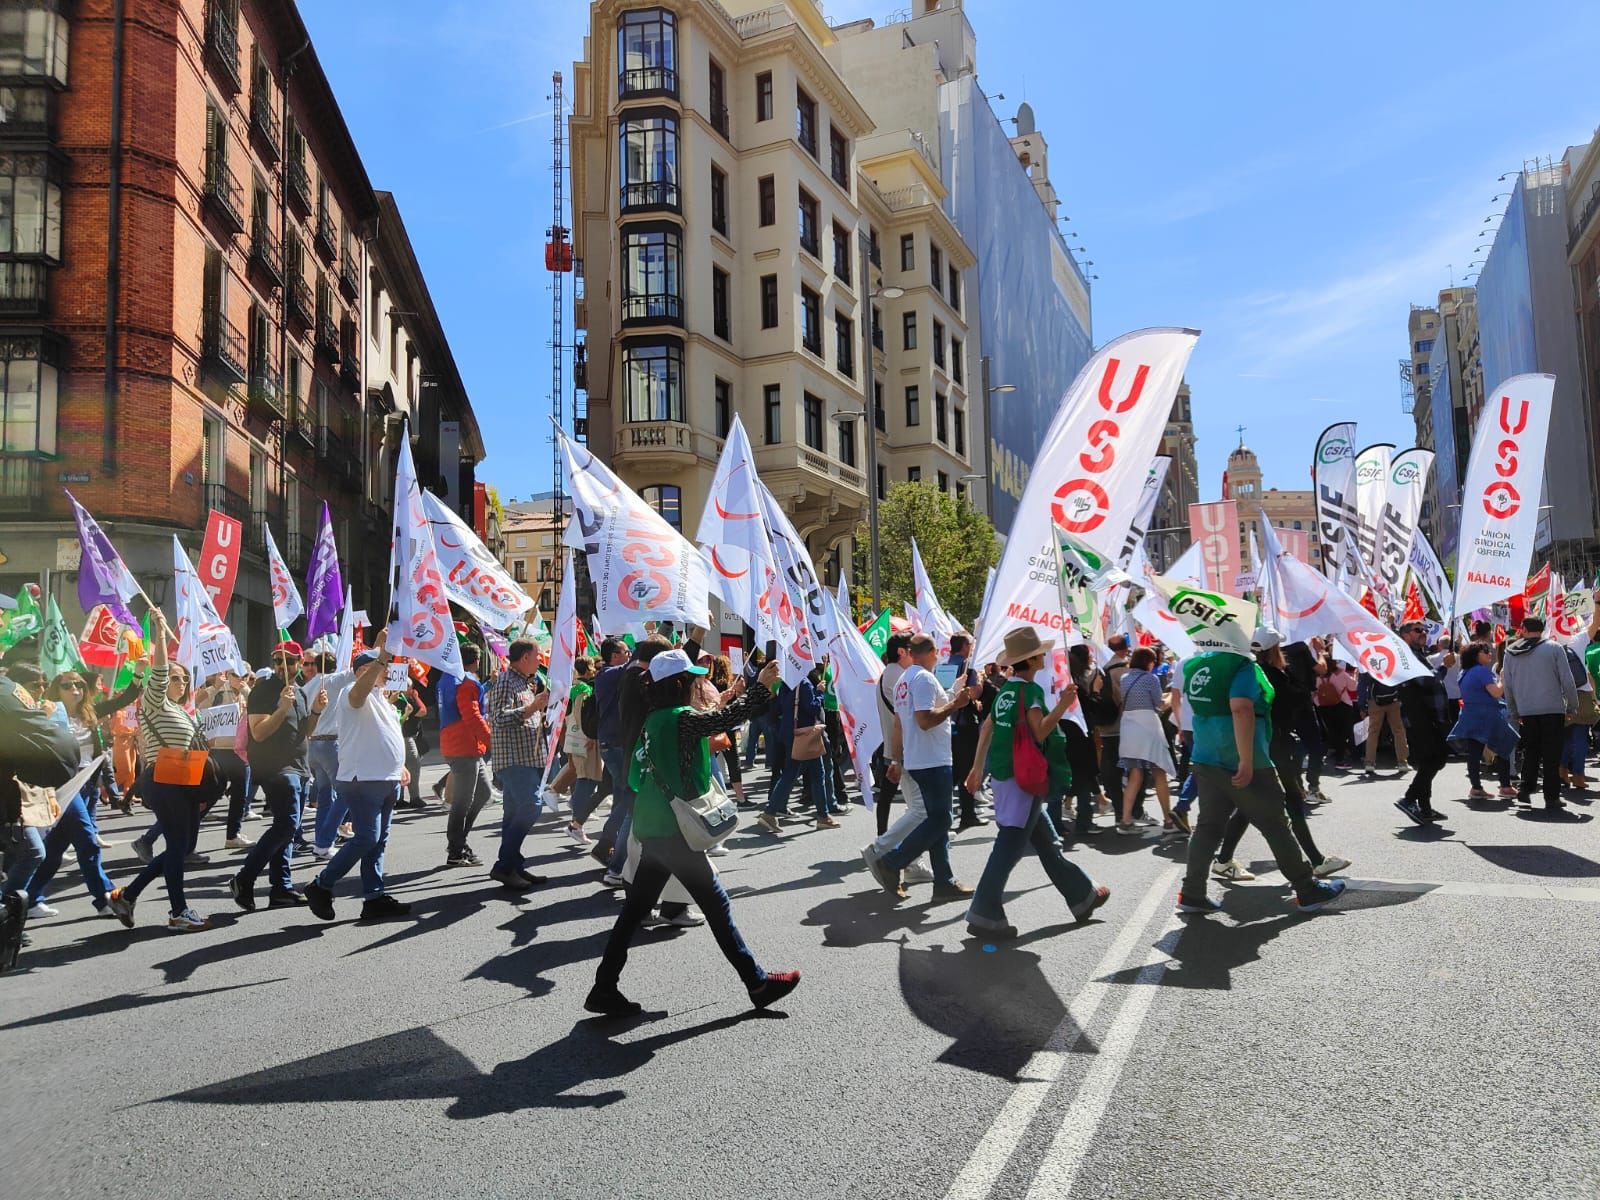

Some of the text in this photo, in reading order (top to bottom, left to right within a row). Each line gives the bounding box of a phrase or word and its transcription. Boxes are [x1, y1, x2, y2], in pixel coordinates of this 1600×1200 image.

[1051, 357, 1151, 534] USO
[1324, 446, 1353, 456] CSIF
[1482, 396, 1530, 520] USO
[1358, 467, 1383, 478] CSIF
[1398, 467, 1420, 480] CSIF
[1381, 502, 1412, 585] CSIF
[1474, 538, 1516, 549] SINDICAL
[1028, 556, 1057, 572] SIND
[448, 560, 521, 609] USO
[1028, 571, 1059, 586] OBRE
[1467, 570, 1511, 588] MÁLAGA
[1007, 601, 1073, 633] MÁLAGA
